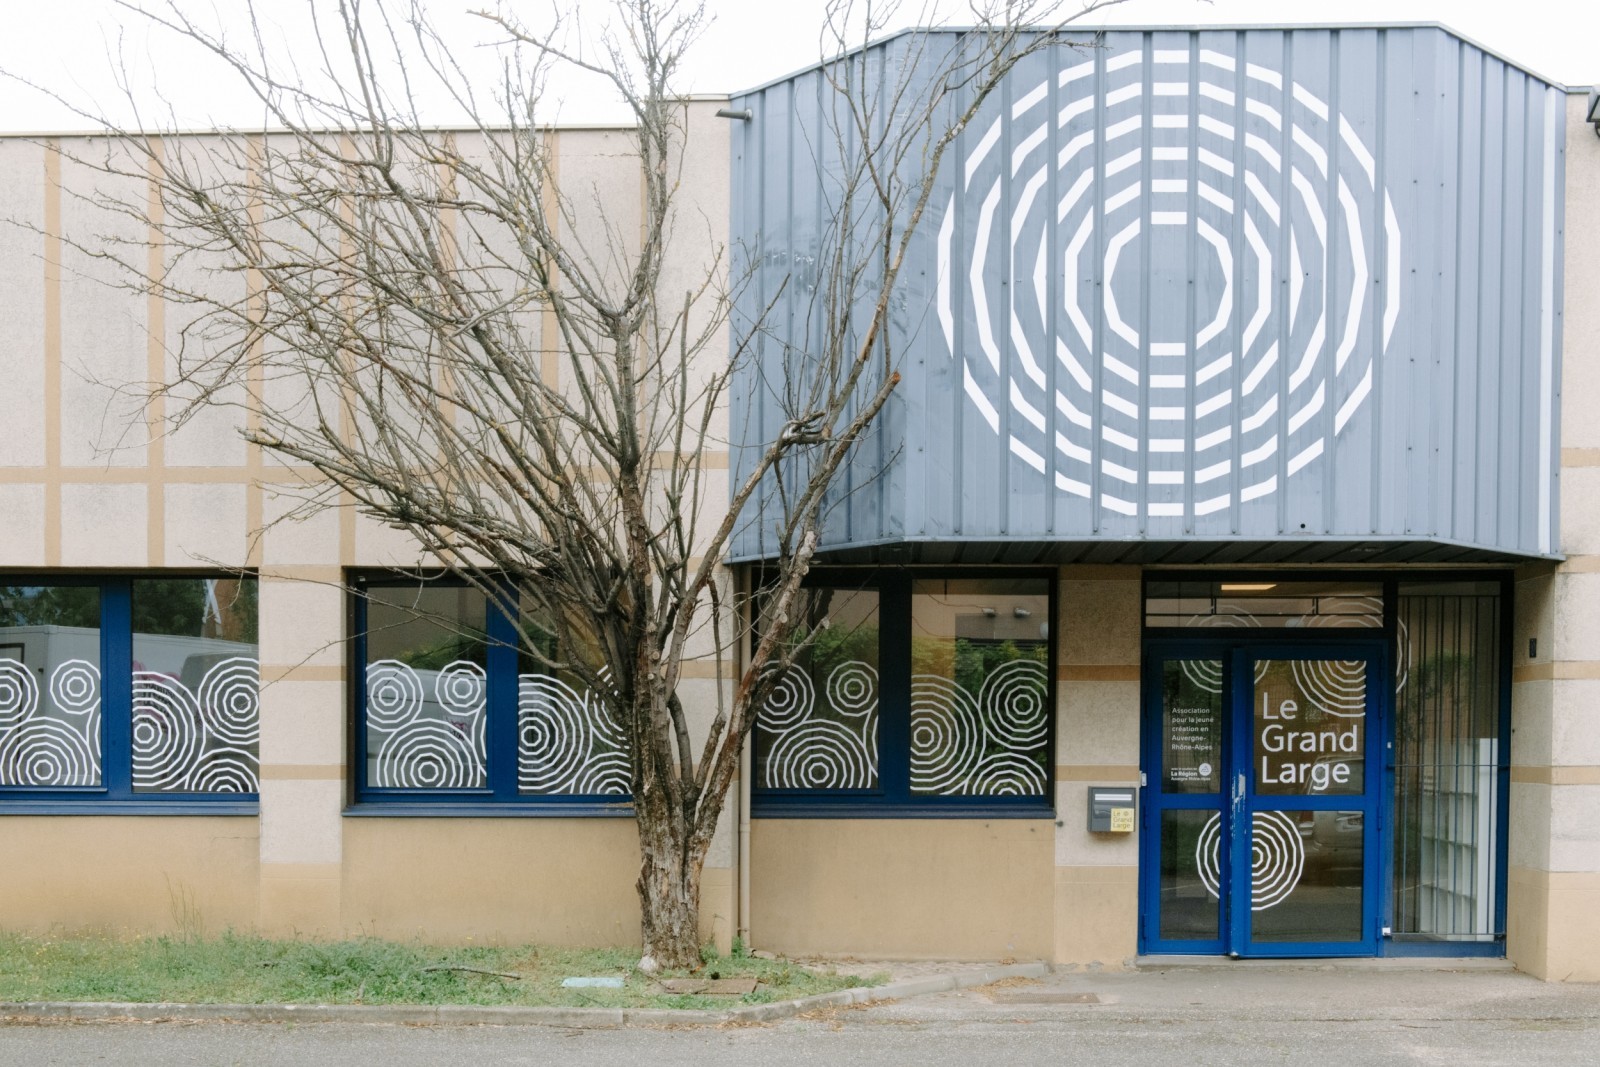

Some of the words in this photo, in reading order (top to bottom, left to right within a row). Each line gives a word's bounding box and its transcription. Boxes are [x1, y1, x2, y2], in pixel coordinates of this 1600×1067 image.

[1263, 692, 1298, 720] Le
[1261, 724, 1358, 752] Grand
[1262, 756, 1350, 790] Large
